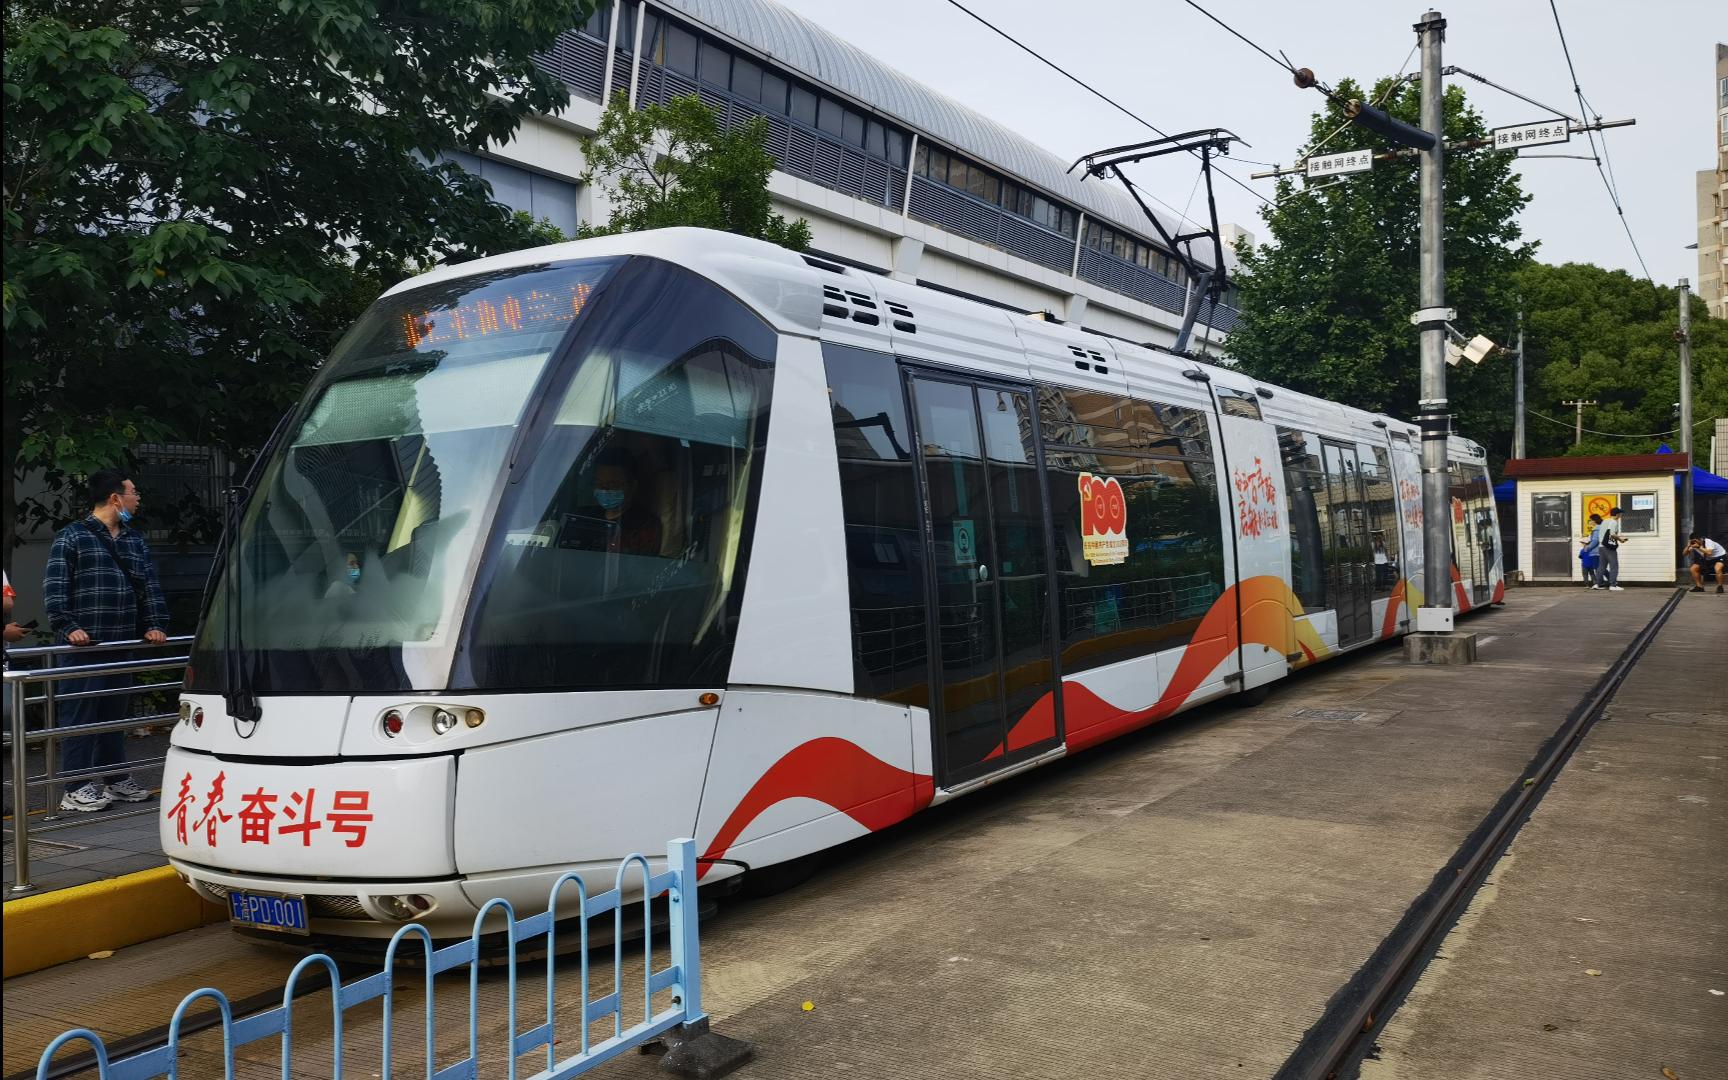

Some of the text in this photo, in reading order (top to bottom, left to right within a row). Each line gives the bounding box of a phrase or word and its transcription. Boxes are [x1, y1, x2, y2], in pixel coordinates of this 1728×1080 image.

[1497, 125, 1565, 145] 接触网终点
[1310, 154, 1369, 173] 接触网终点
[167, 770, 373, 848] 青春奋斗号
